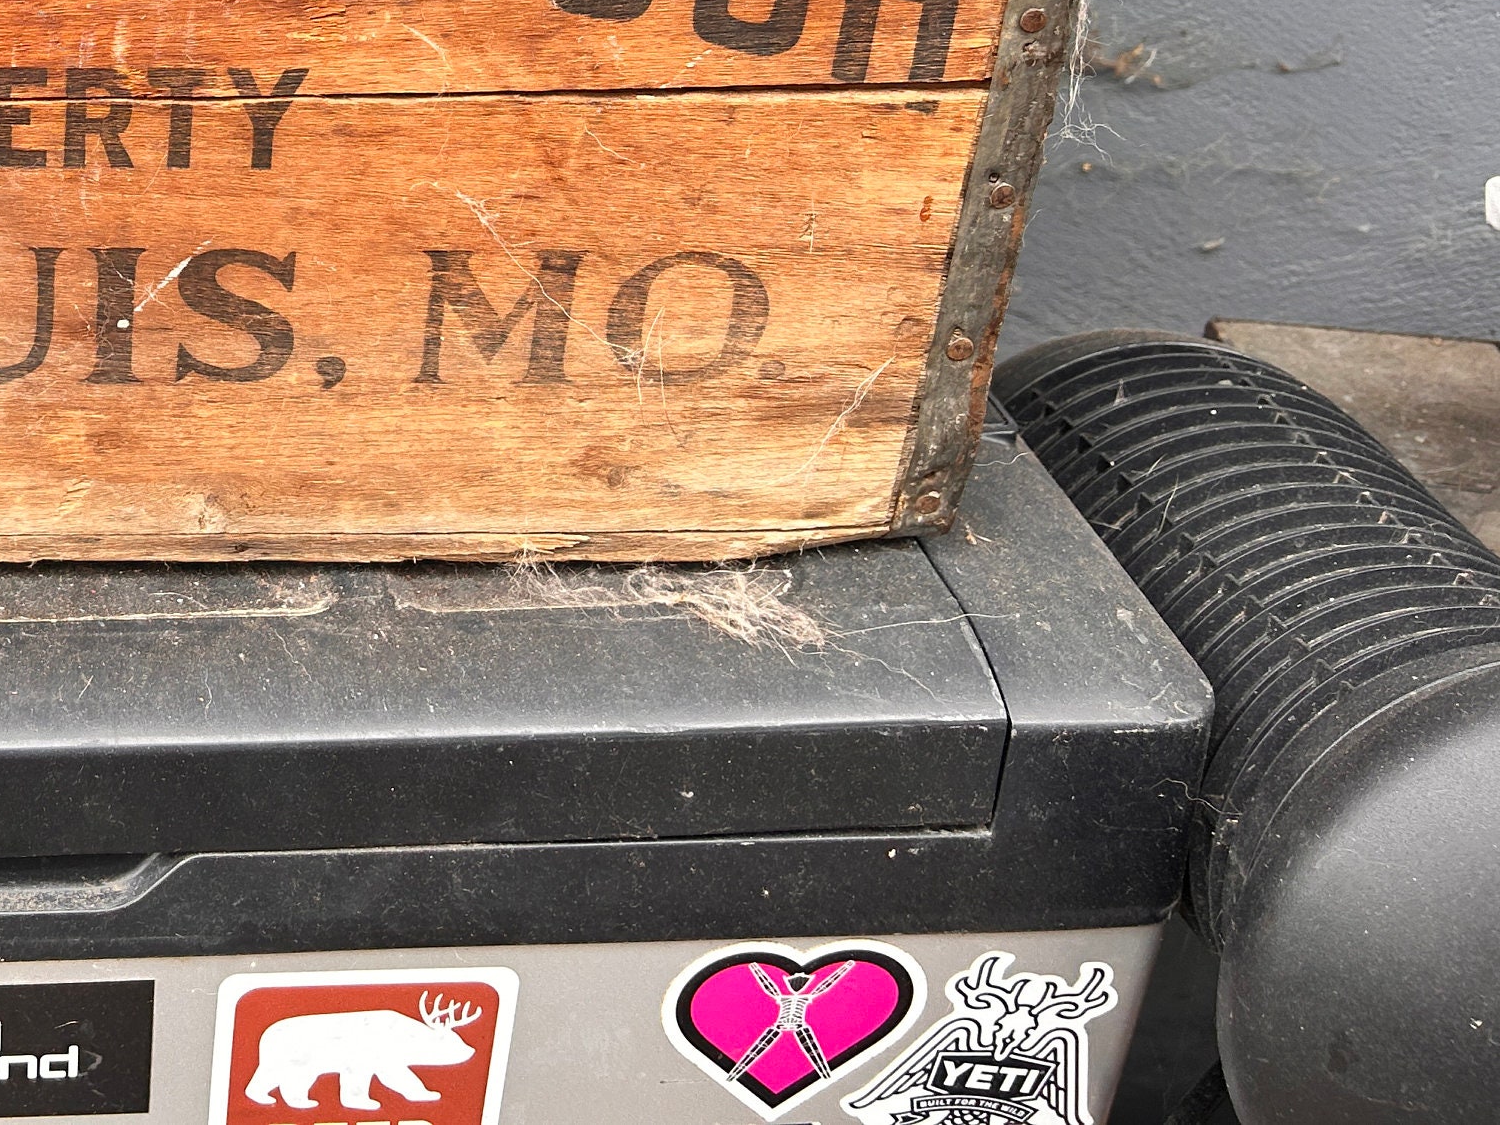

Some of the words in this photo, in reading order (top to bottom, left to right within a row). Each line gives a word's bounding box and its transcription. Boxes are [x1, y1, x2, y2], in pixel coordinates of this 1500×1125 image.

[414, 249, 787, 386] MO.
[942, 1060, 1041, 1094] YETI
[920, 1099, 952, 1109] BUILT
[955, 1098, 977, 1107] FOR
[979, 1099, 998, 1110] THE
[1000, 1104, 1026, 1118] WILD
